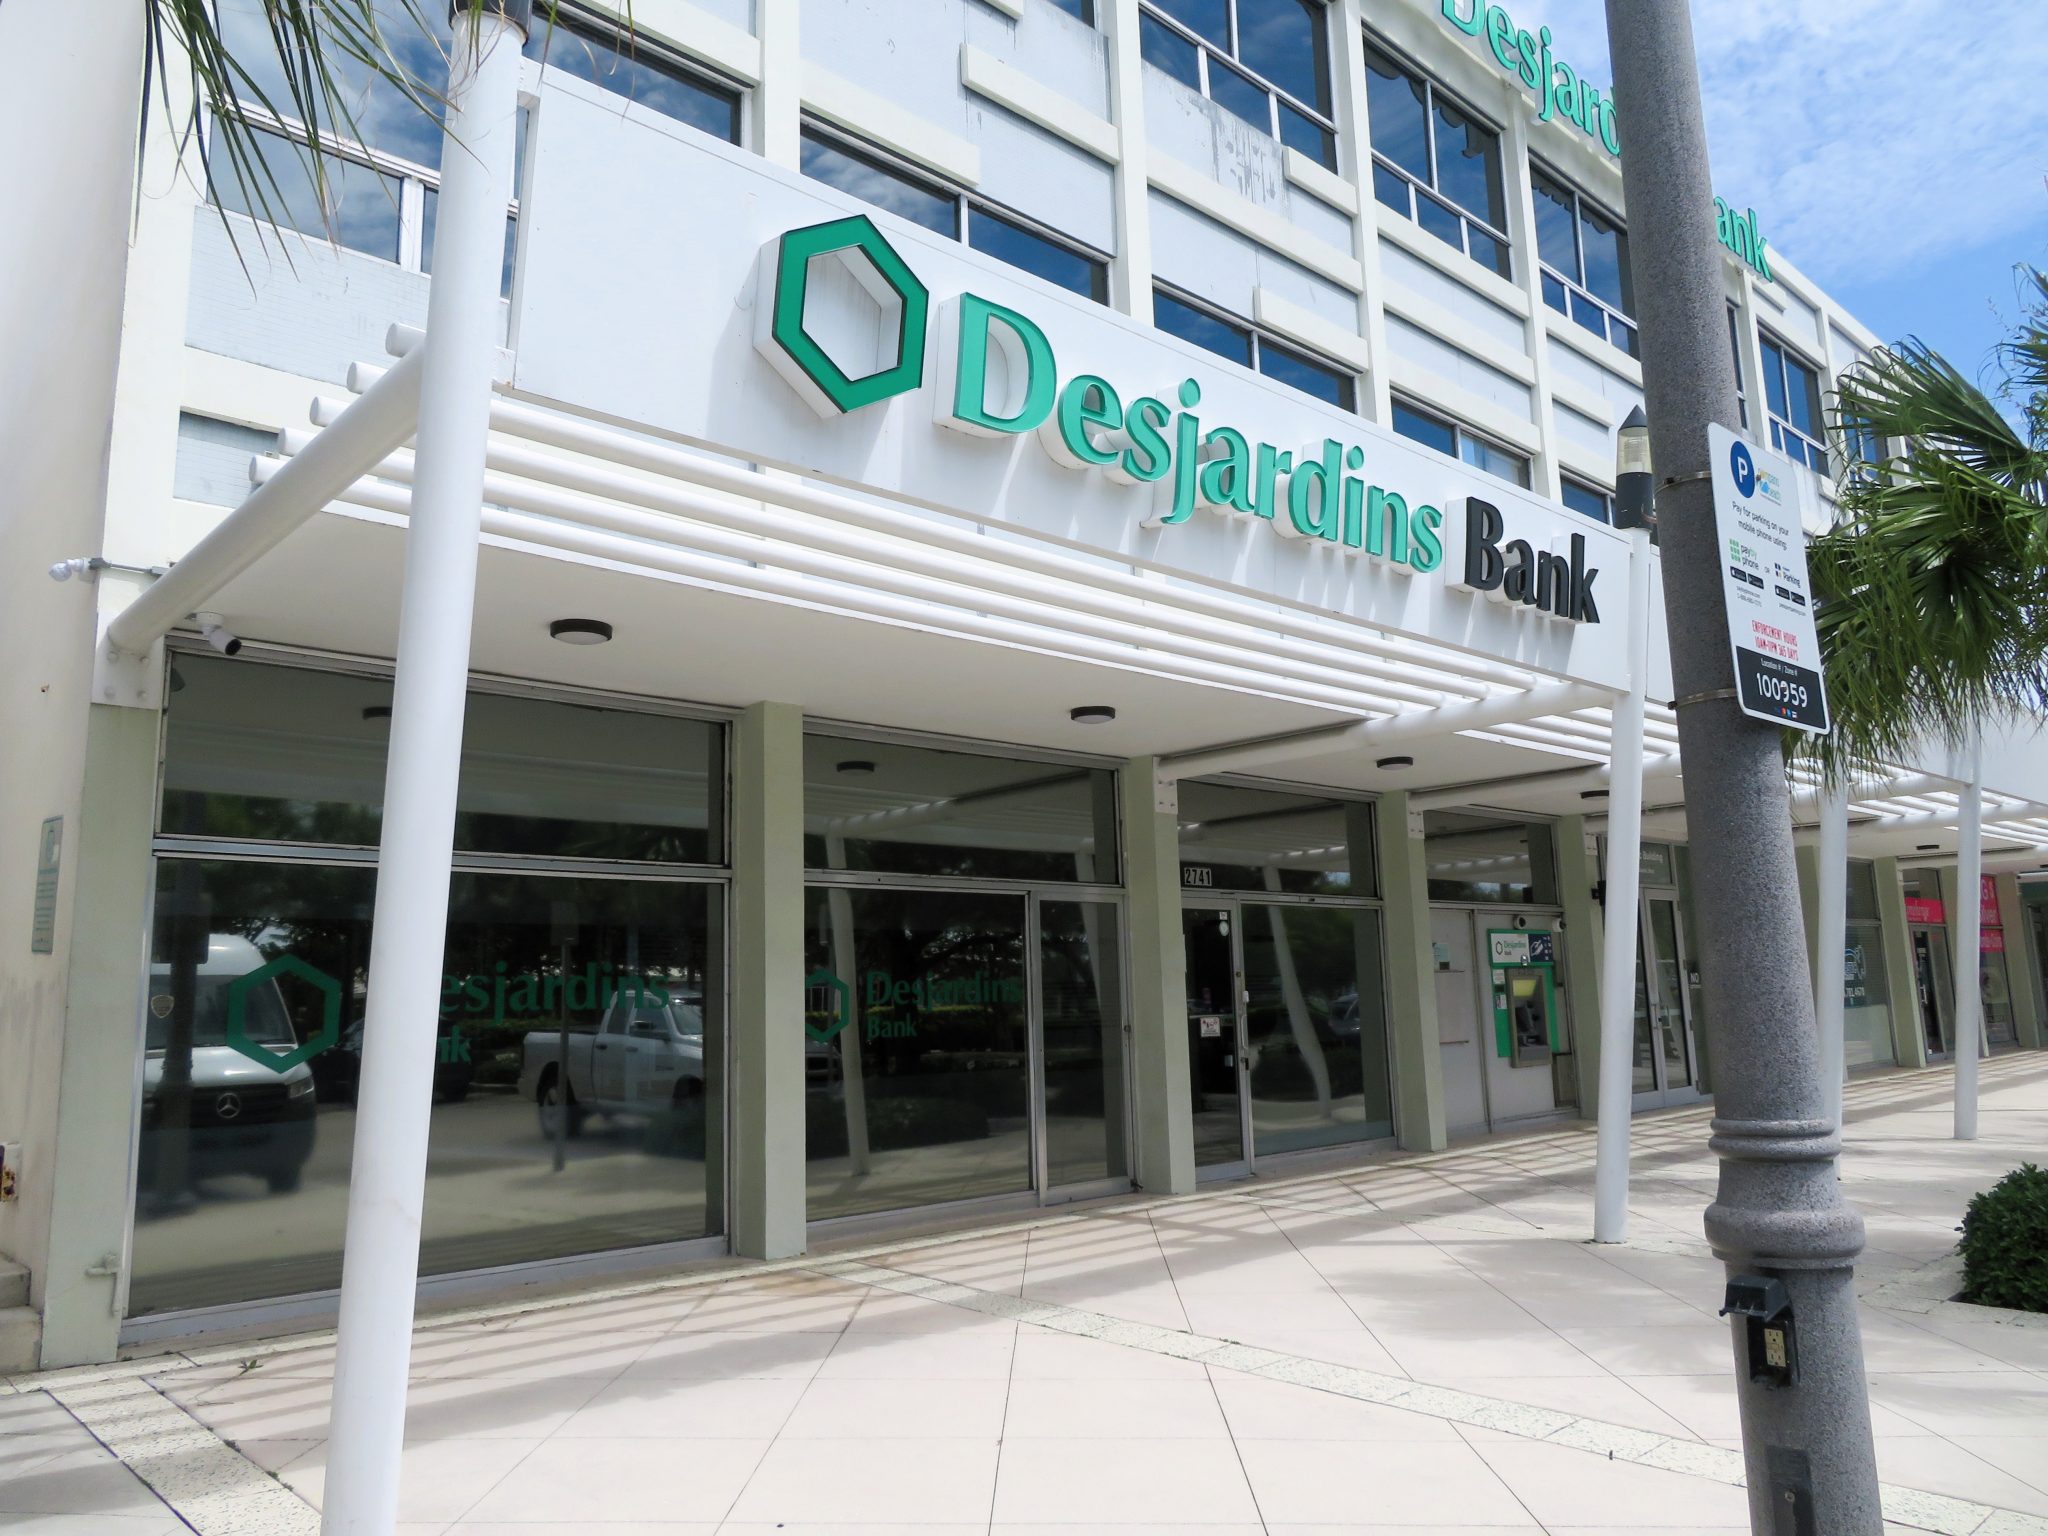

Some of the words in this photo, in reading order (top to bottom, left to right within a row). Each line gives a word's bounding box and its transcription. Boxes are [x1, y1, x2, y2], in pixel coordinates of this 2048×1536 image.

[1713, 196, 1773, 283] ank
[953, 292, 1443, 573] Desjardins
[1463, 496, 1600, 623] Bank
[1737, 456, 1749, 483] P
[1732, 501, 1742, 515] Pay
[1751, 512, 1771, 529] parking
[1738, 520, 1756, 534] mobile
[1756, 529, 1772, 542] phone
[1742, 555, 1759, 570] phone
[1783, 571, 1801, 588] Parking
[1186, 868, 1211, 886] 2741
[440, 959, 670, 1025] esjardins
[866, 969, 1023, 1012] Desjardins
[868, 1014, 918, 1040] Bank
